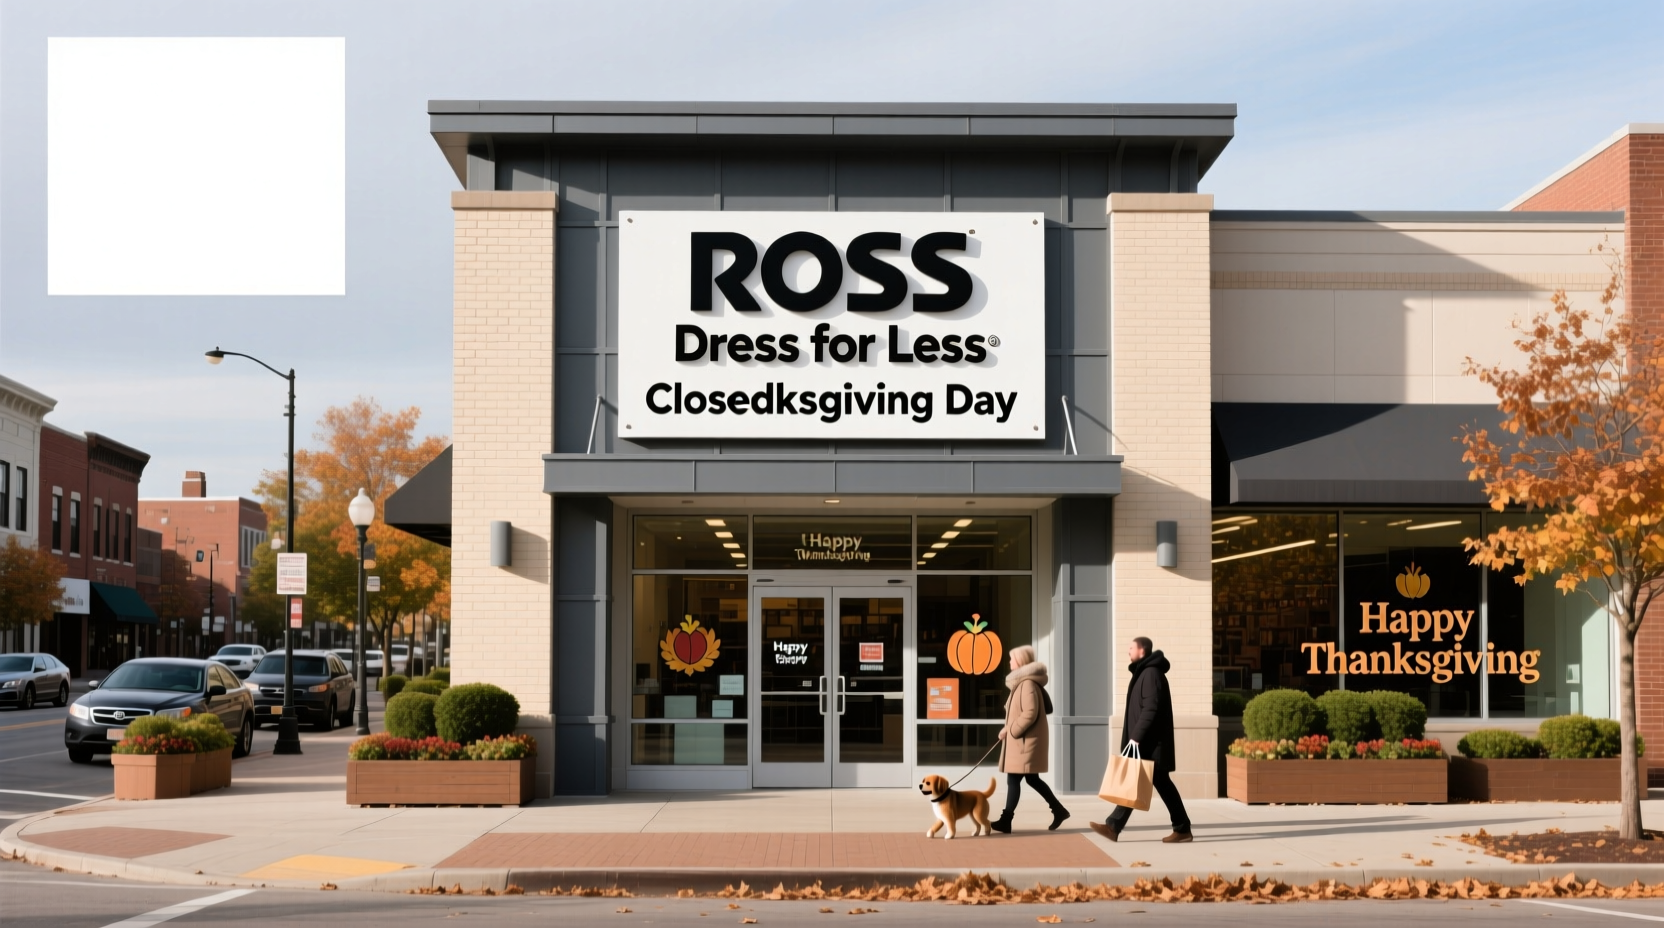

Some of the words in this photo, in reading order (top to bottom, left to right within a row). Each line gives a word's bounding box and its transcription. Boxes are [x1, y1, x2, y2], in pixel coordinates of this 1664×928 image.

[690, 231, 974, 313] ROSS
[675, 324, 800, 363] Dress
[810, 322, 876, 363] for
[645, 381, 933, 424] Closedksgiving
[946, 383, 1018, 423] Day
[1359, 602, 1475, 642] Happy
[1300, 641, 1541, 684] Thanksgiving
